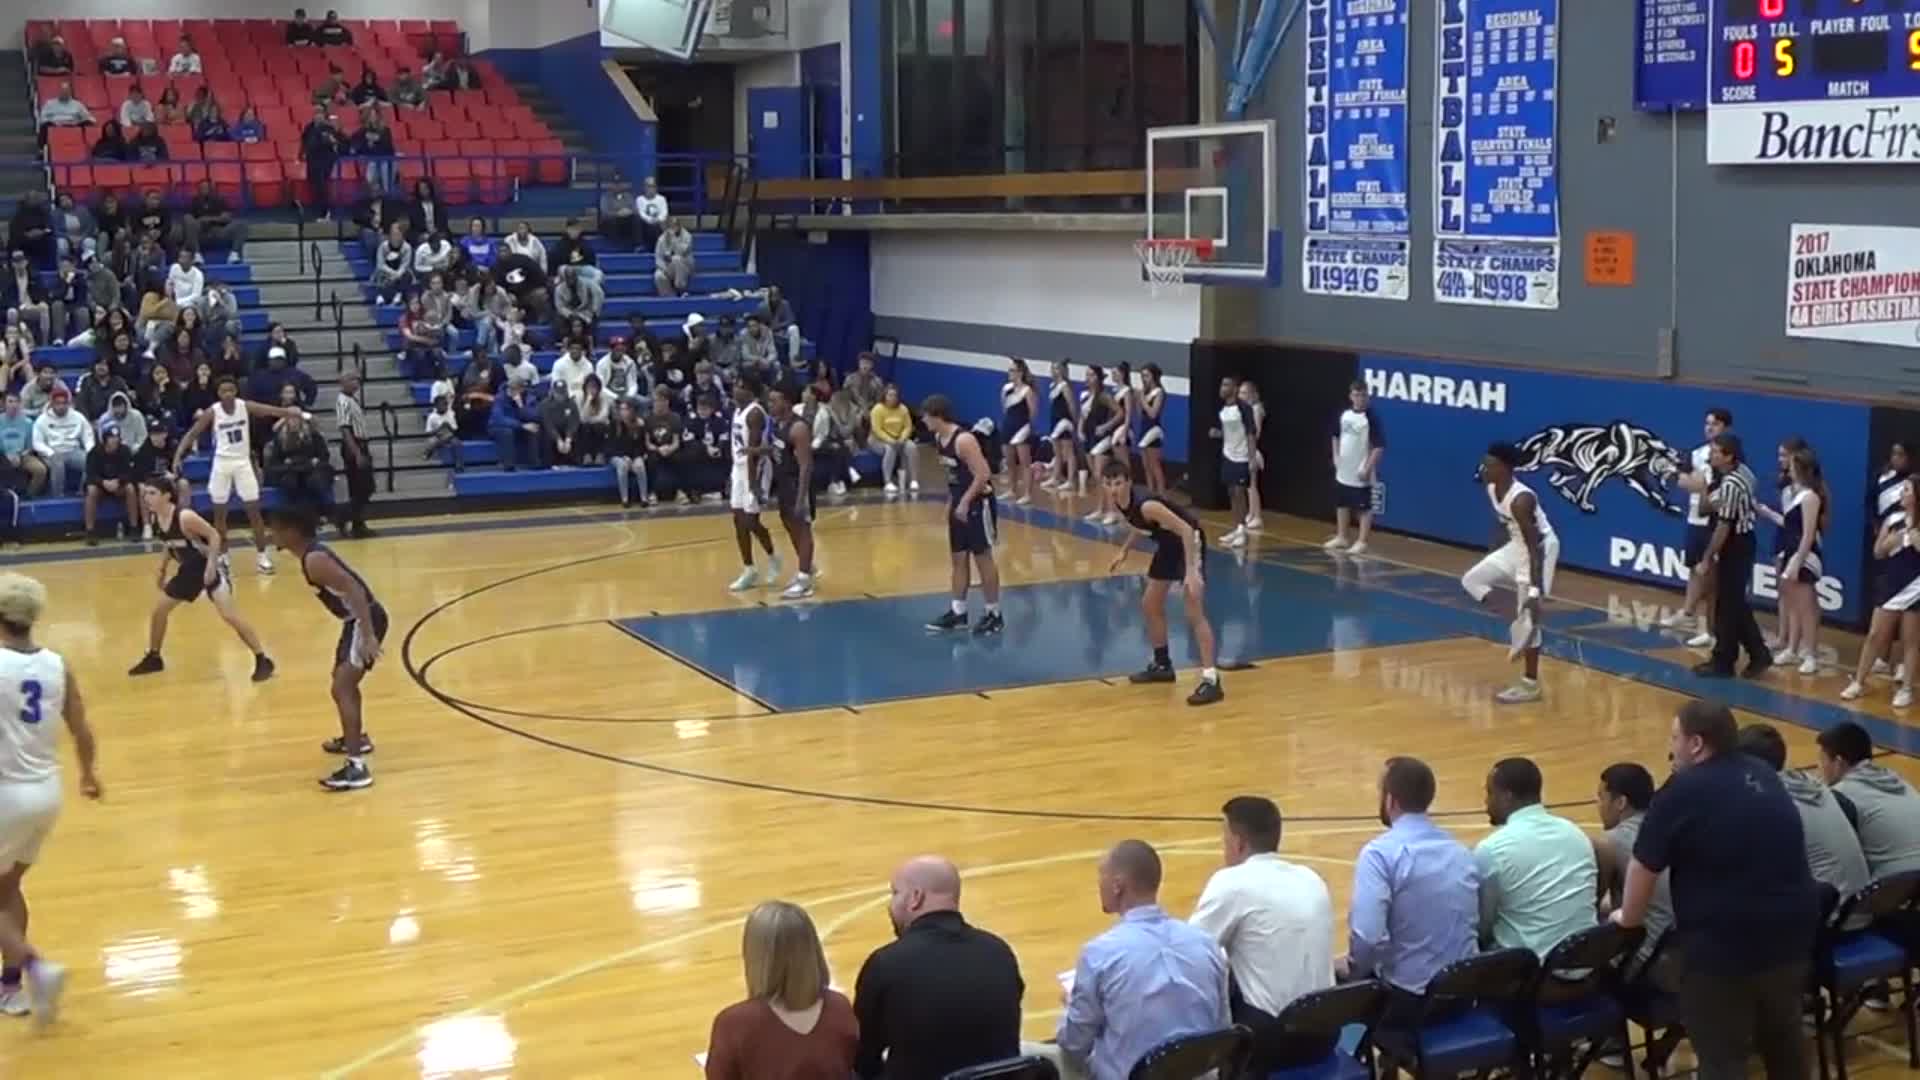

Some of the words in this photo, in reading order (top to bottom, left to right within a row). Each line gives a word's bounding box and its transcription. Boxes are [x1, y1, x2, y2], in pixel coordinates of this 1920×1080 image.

[1723, 24, 1758, 40] FOULS
[1811, 18, 1855, 34] PLAYER
[1861, 15, 1891, 32] FOUL
[1735, 42, 1755, 78] 0
[1775, 39, 1794, 76] 5
[1722, 85, 1756, 101] SCORE
[1828, 81, 1869, 96] MATCH
[1796, 232, 1829, 255] 2017
[1306, 249, 1347, 264] STATE
[1352, 250, 1406, 267] CHAMPS
[1437, 253, 1484, 270] STATE
[1489, 256, 1555, 273] CHAMPS
[1795, 250, 1876, 279] OKLAHOMA
[1793, 280, 1837, 303] STATE
[1812, 301, 1849, 325] GIRLS
[1364, 367, 1506, 413] HARRAH
[1610, 537, 1844, 612] PANES
[19, 679, 42, 724] 3
